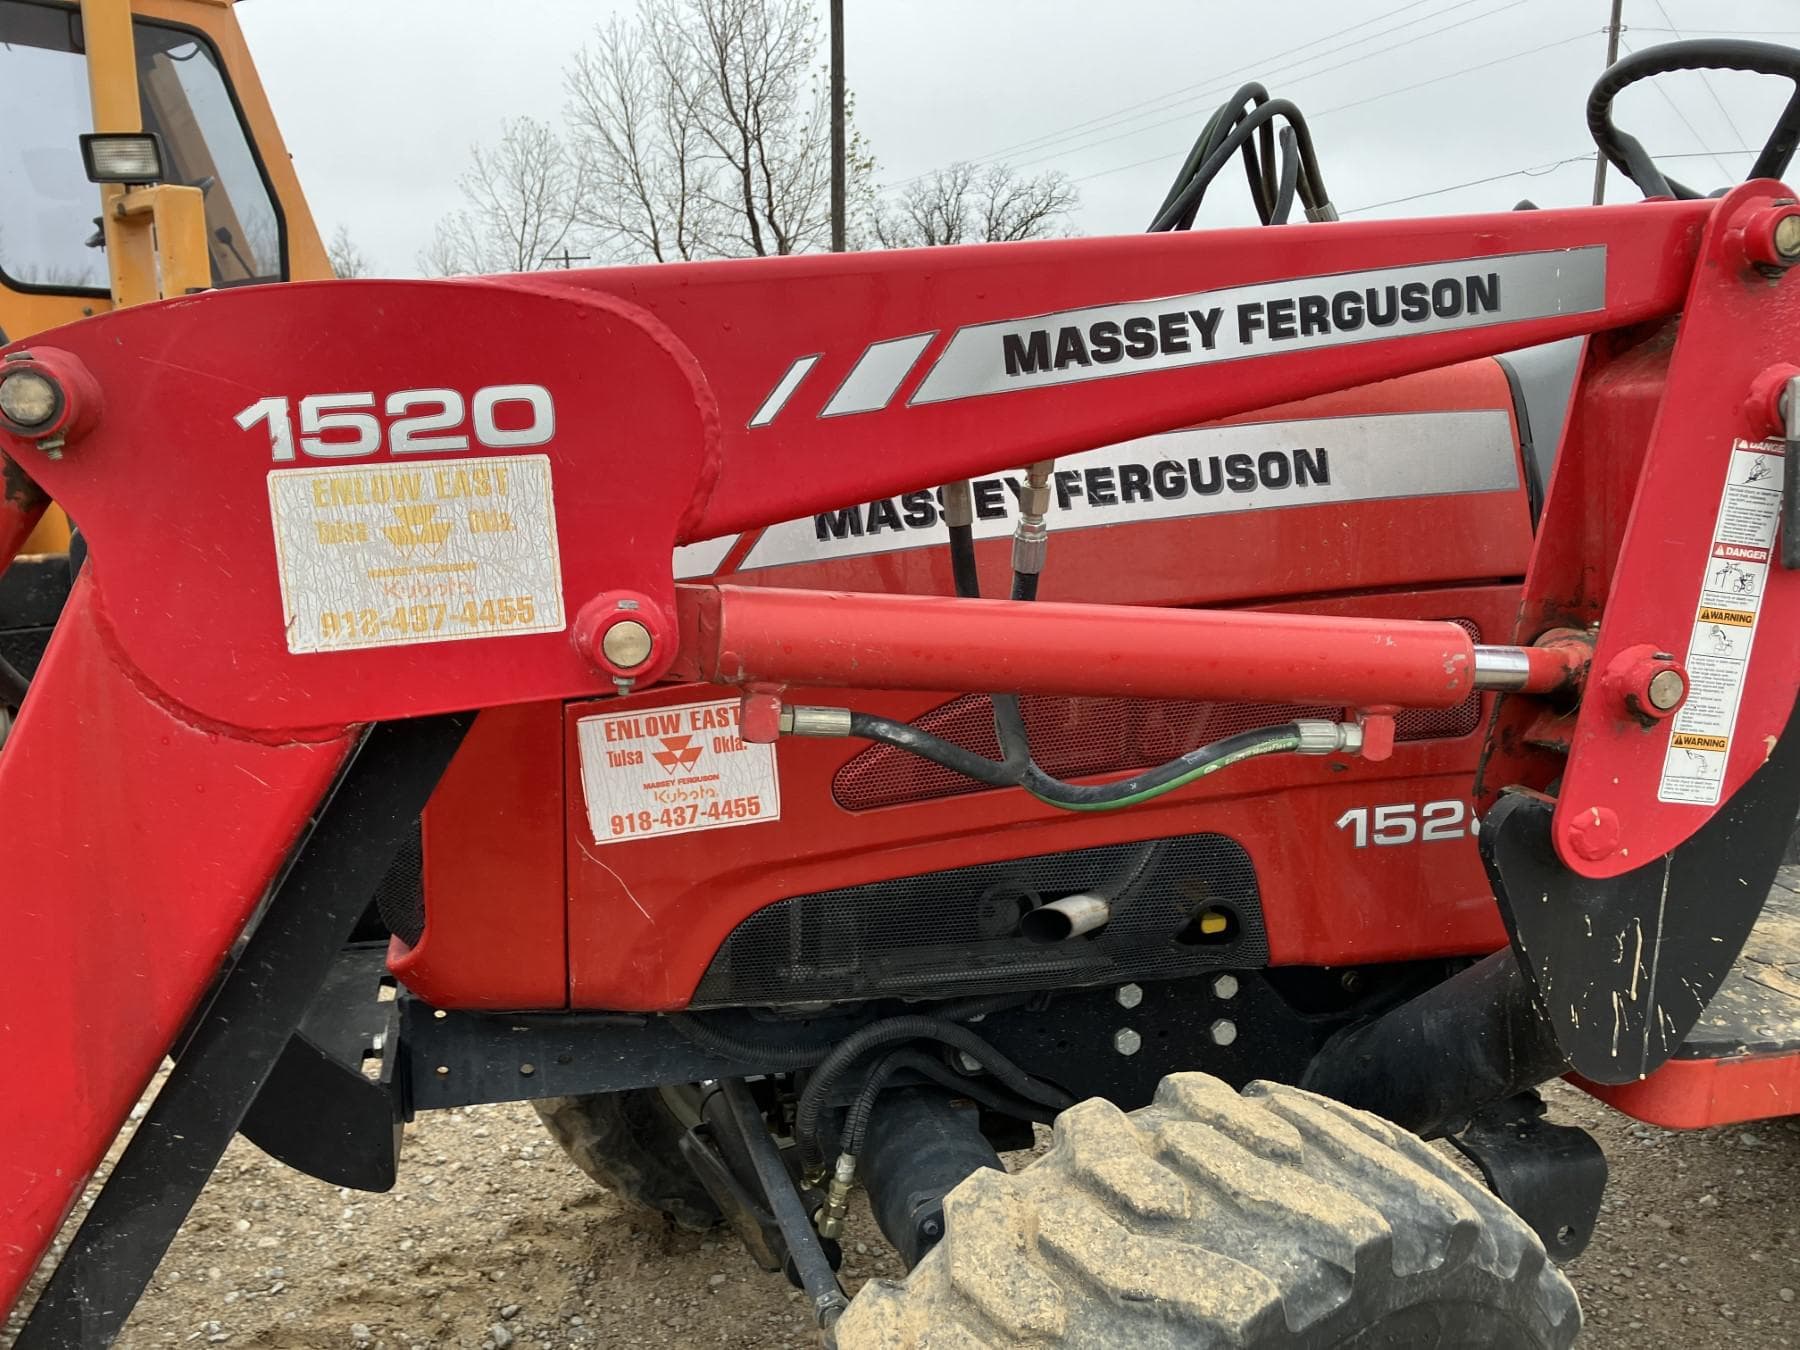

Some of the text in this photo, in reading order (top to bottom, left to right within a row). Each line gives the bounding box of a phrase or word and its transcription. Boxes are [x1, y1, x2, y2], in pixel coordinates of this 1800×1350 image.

[1003, 273, 1500, 376] MASSEY FERGUSON
[233, 384, 556, 462] 1520
[312, 468, 508, 507] ENLOW EAST
[1054, 447, 1331, 511] FERGUSON
[1725, 546, 1767, 560] DANGER
[1710, 610, 1753, 624] WARNING
[604, 705, 741, 742] ENLOW EAST
[1683, 736, 1726, 748] WARNING
[606, 735, 748, 768] Tulsa Okla.
[643, 773, 720, 790] MASSEY FERGUSON
[654, 786, 717, 804] Kubota
[611, 796, 761, 836] 918-437-4455
[1335, 799, 1480, 848] 152
